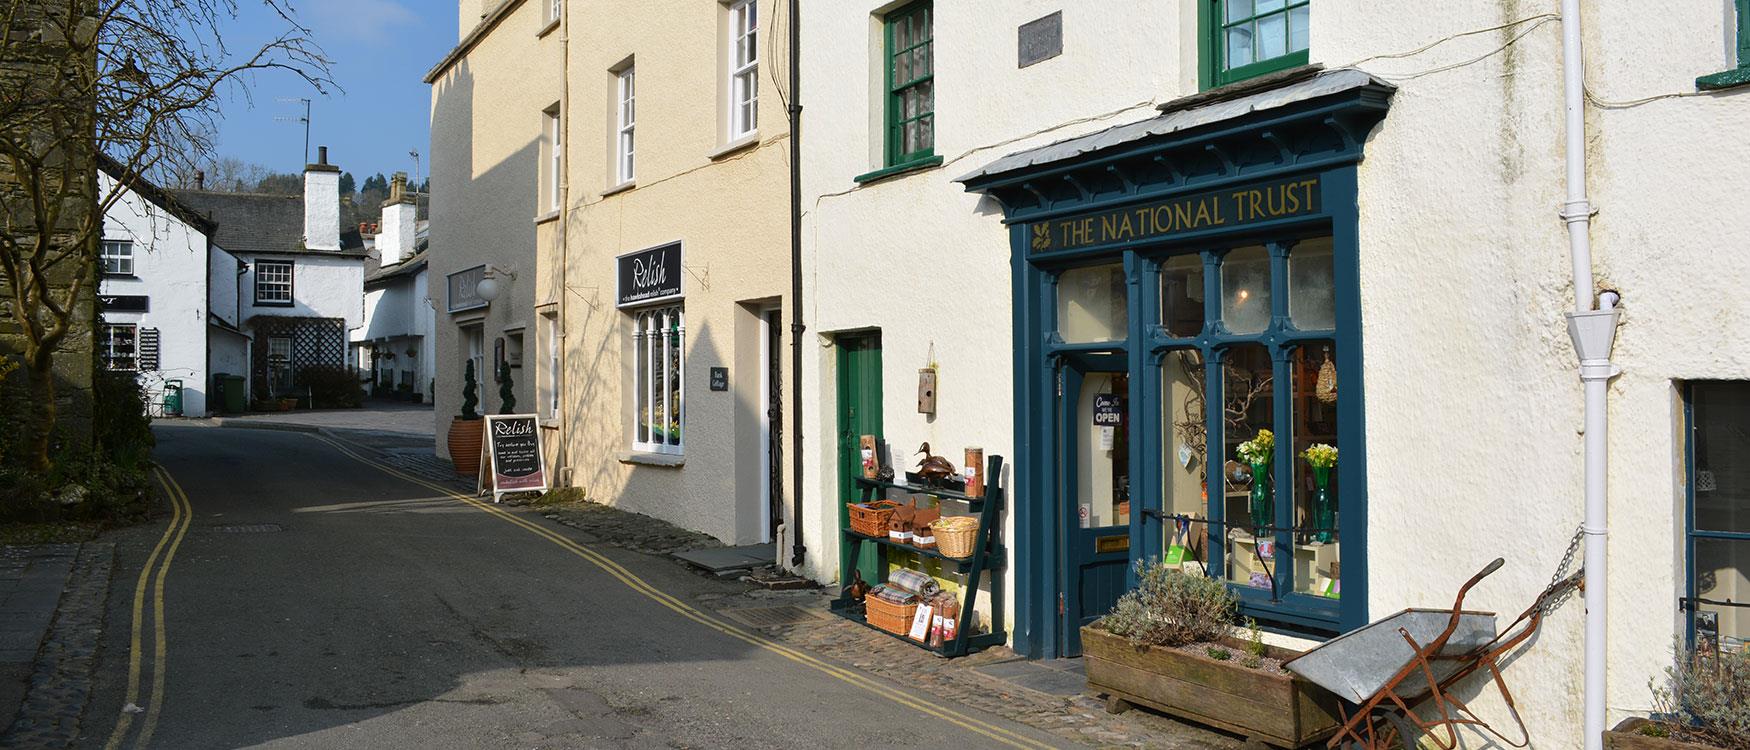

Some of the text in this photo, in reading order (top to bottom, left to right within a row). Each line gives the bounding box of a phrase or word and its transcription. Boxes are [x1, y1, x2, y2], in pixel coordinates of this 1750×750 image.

[1060, 178, 1318, 247] THE NATIONAL TRUST
[632, 250, 667, 290] Relish
[495, 420, 534, 435] Relish
[1095, 412, 1120, 423] OPEN
